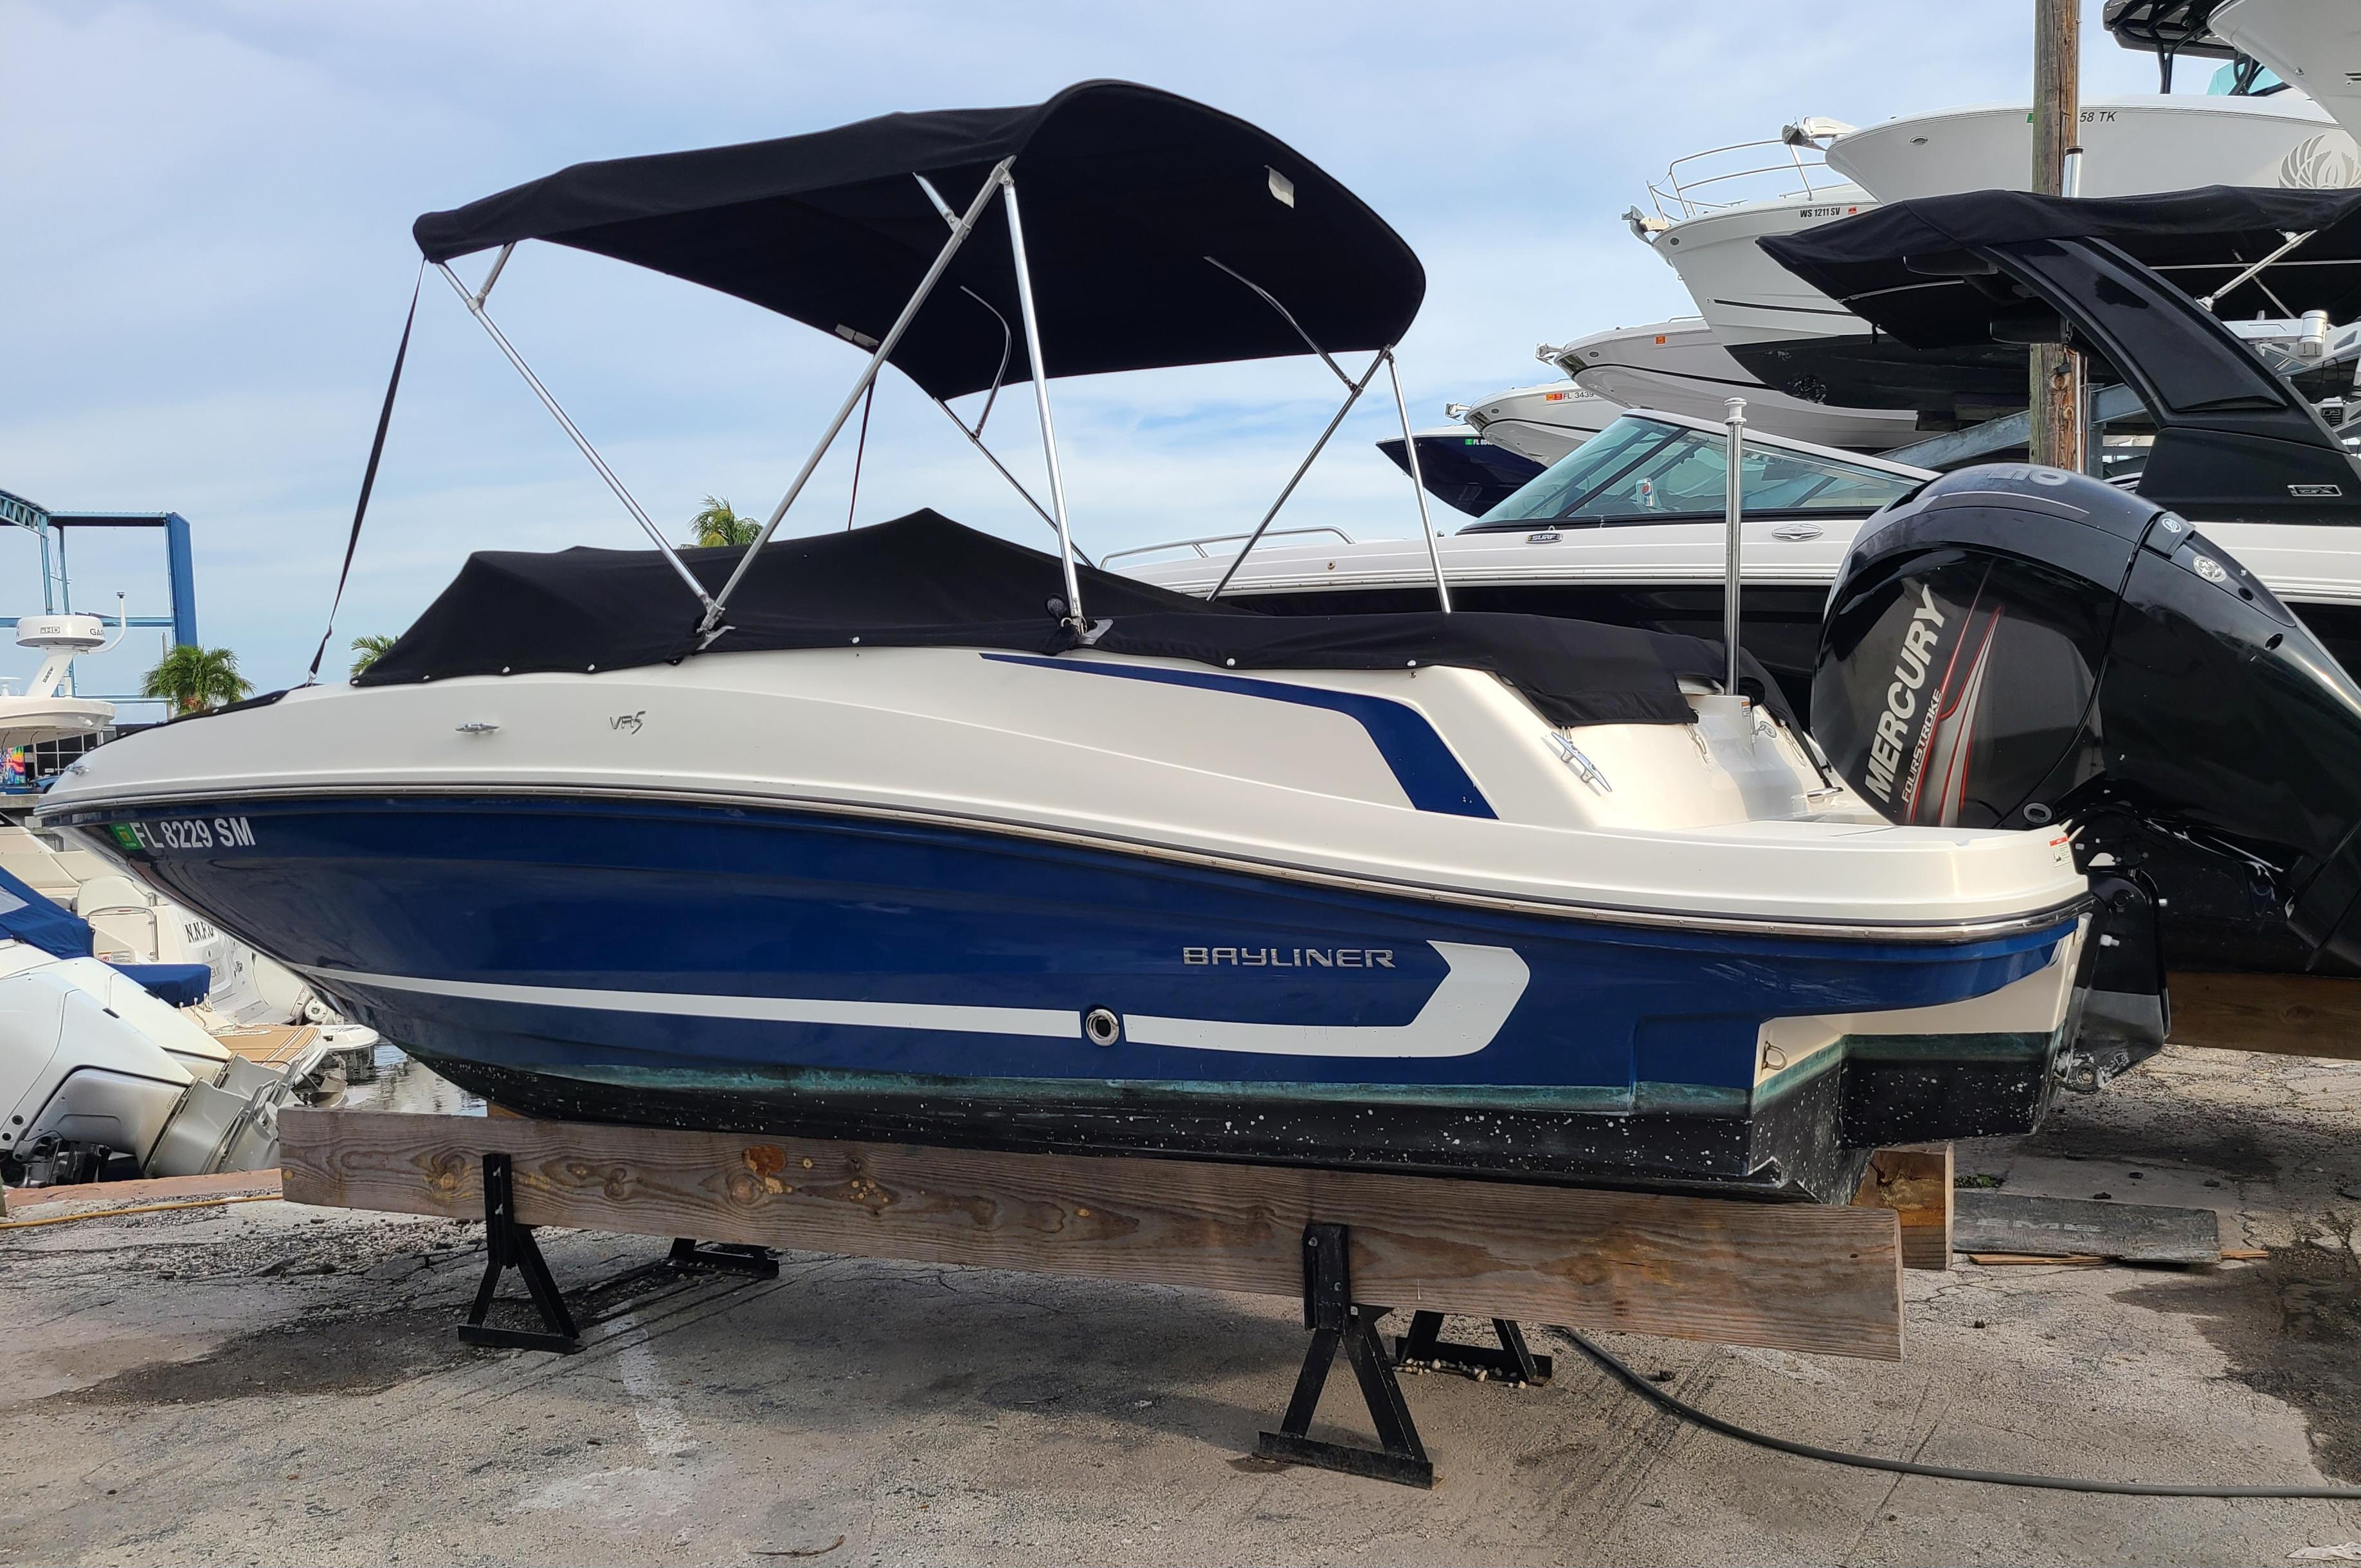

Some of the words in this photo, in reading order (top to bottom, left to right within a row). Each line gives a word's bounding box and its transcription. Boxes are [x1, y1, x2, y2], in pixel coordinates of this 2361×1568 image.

[2099, 111, 2117, 122] TK
[1800, 209, 1813, 218] WS
[1814, 208, 1829, 217] 1211
[1831, 207, 1841, 216] SV
[1865, 584, 1945, 804] MERCURY
[1901, 688, 1942, 803] FOURSTROKE
[129, 822, 165, 848] FL
[161, 819, 213, 849] 8229
[214, 816, 256, 847] SM
[1182, 947, 1396, 968] BAYLINER
